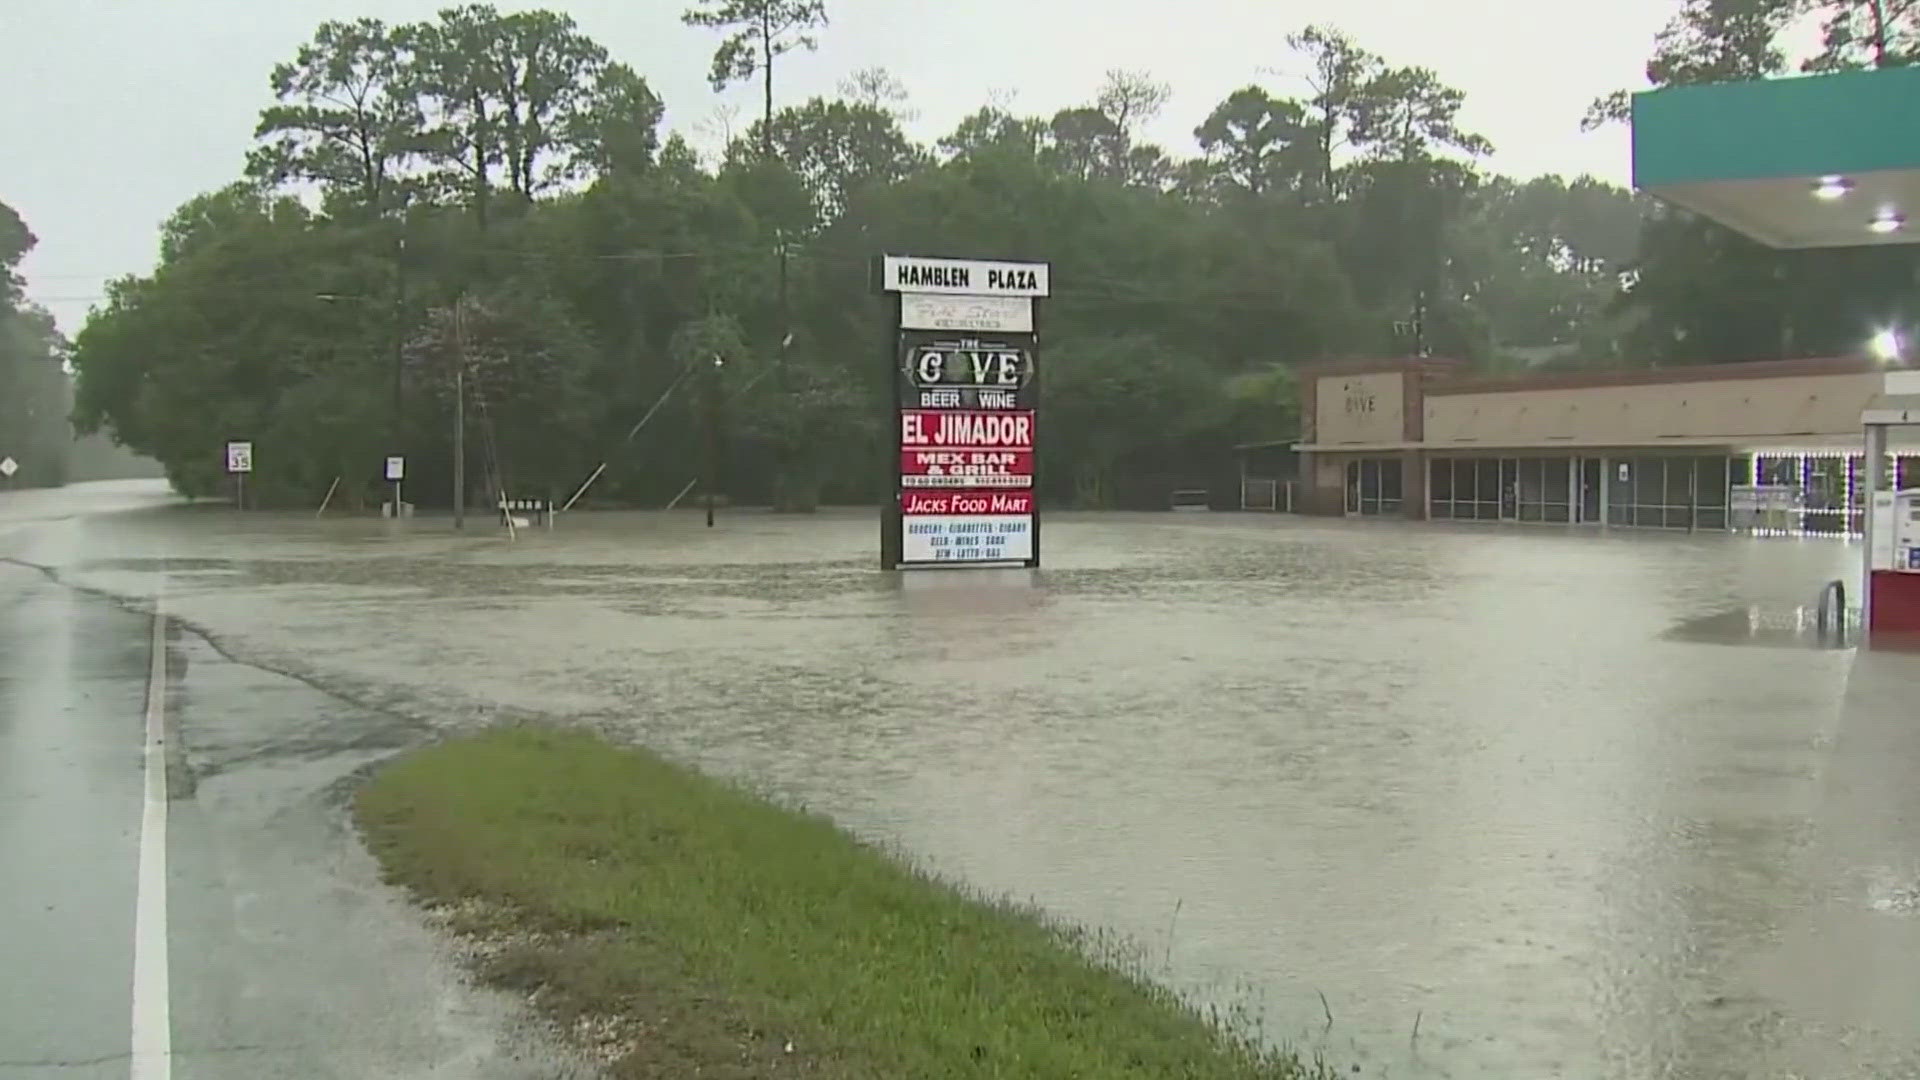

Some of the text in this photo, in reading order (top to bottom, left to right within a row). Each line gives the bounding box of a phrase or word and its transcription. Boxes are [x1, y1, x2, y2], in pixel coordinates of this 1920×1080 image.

[898, 265, 1038, 290] HAMBLEN PLAZA
[960, 339, 979, 349] THE
[920, 392, 1016, 408] BEER WINE
[902, 415, 1030, 445] EL JIMADOR
[917, 453, 1016, 464] MEX BAR
[927, 465, 1010, 475] & GRILL
